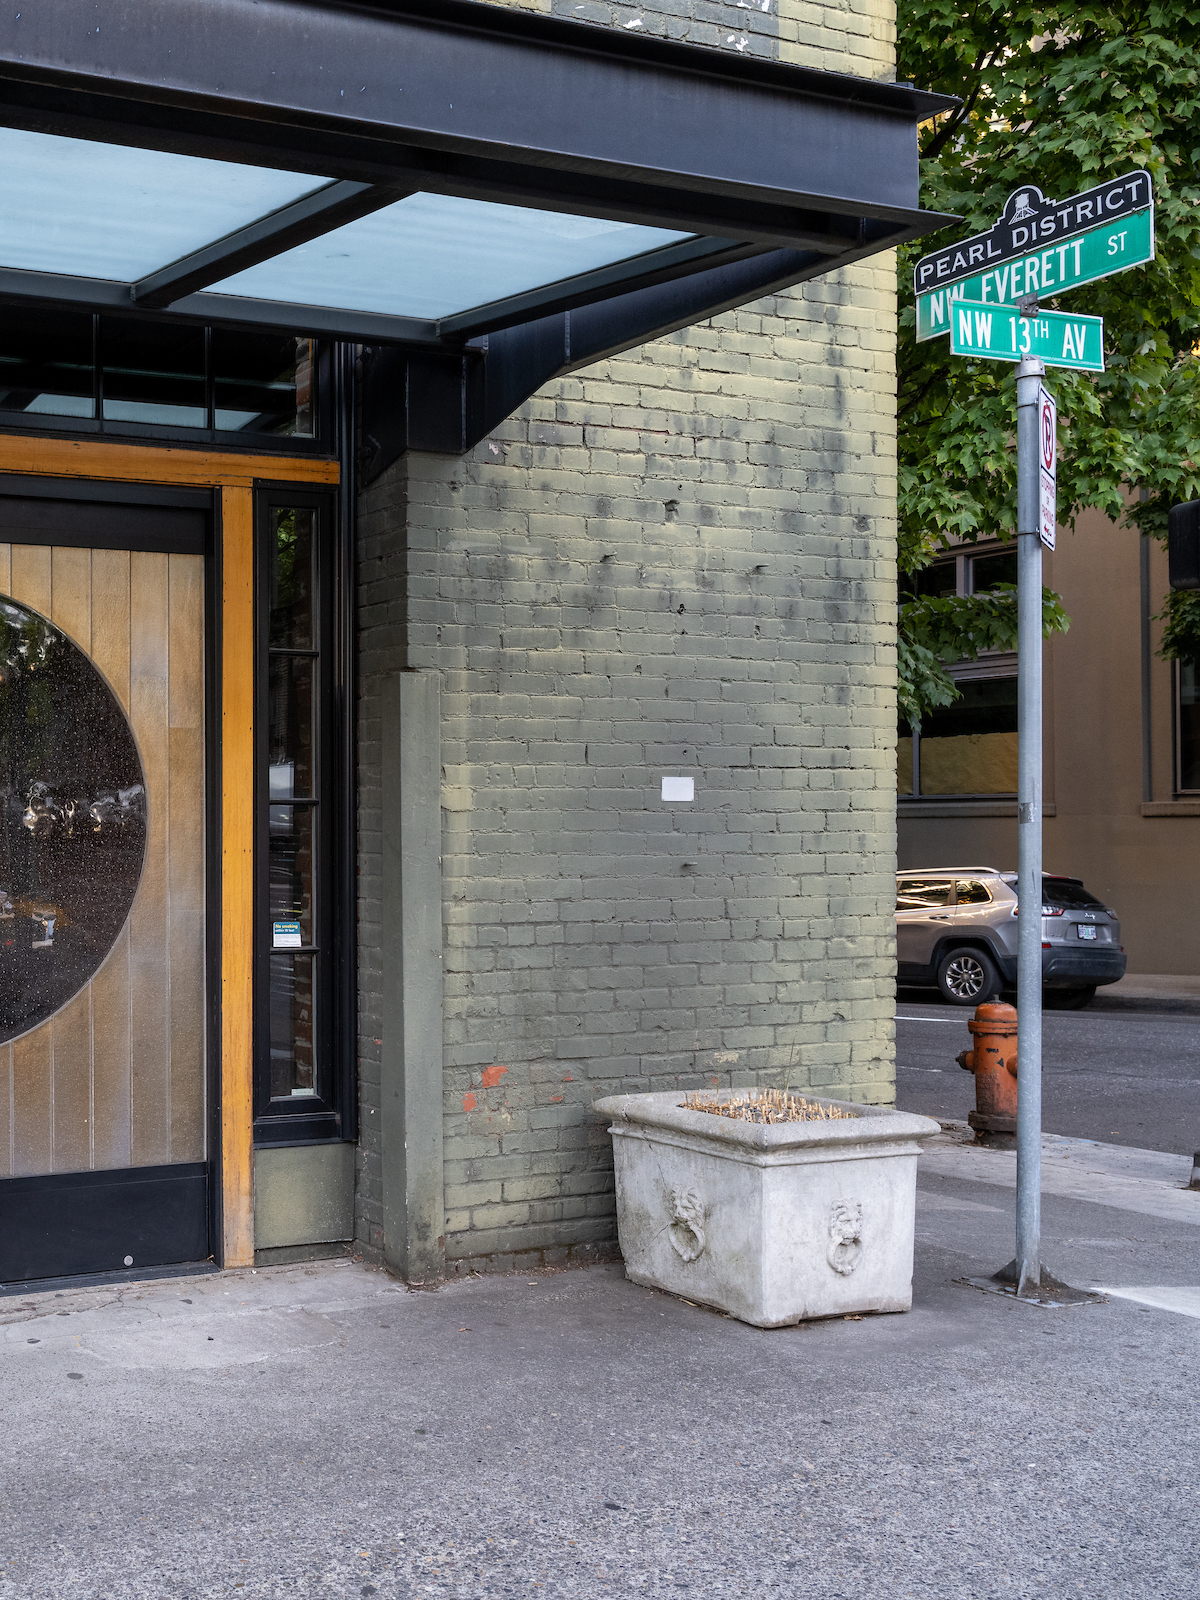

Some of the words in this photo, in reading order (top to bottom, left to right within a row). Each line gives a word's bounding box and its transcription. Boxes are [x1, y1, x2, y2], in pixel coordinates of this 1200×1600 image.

[919, 239, 1002, 285] PEARL
[1011, 178, 1143, 249] DISTRICT
[981, 238, 1085, 304] EVERETT
[1107, 231, 1127, 255] ST
[959, 309, 992, 349] NW
[1009, 316, 1049, 354] 13TH
[1062, 323, 1086, 360] AV
